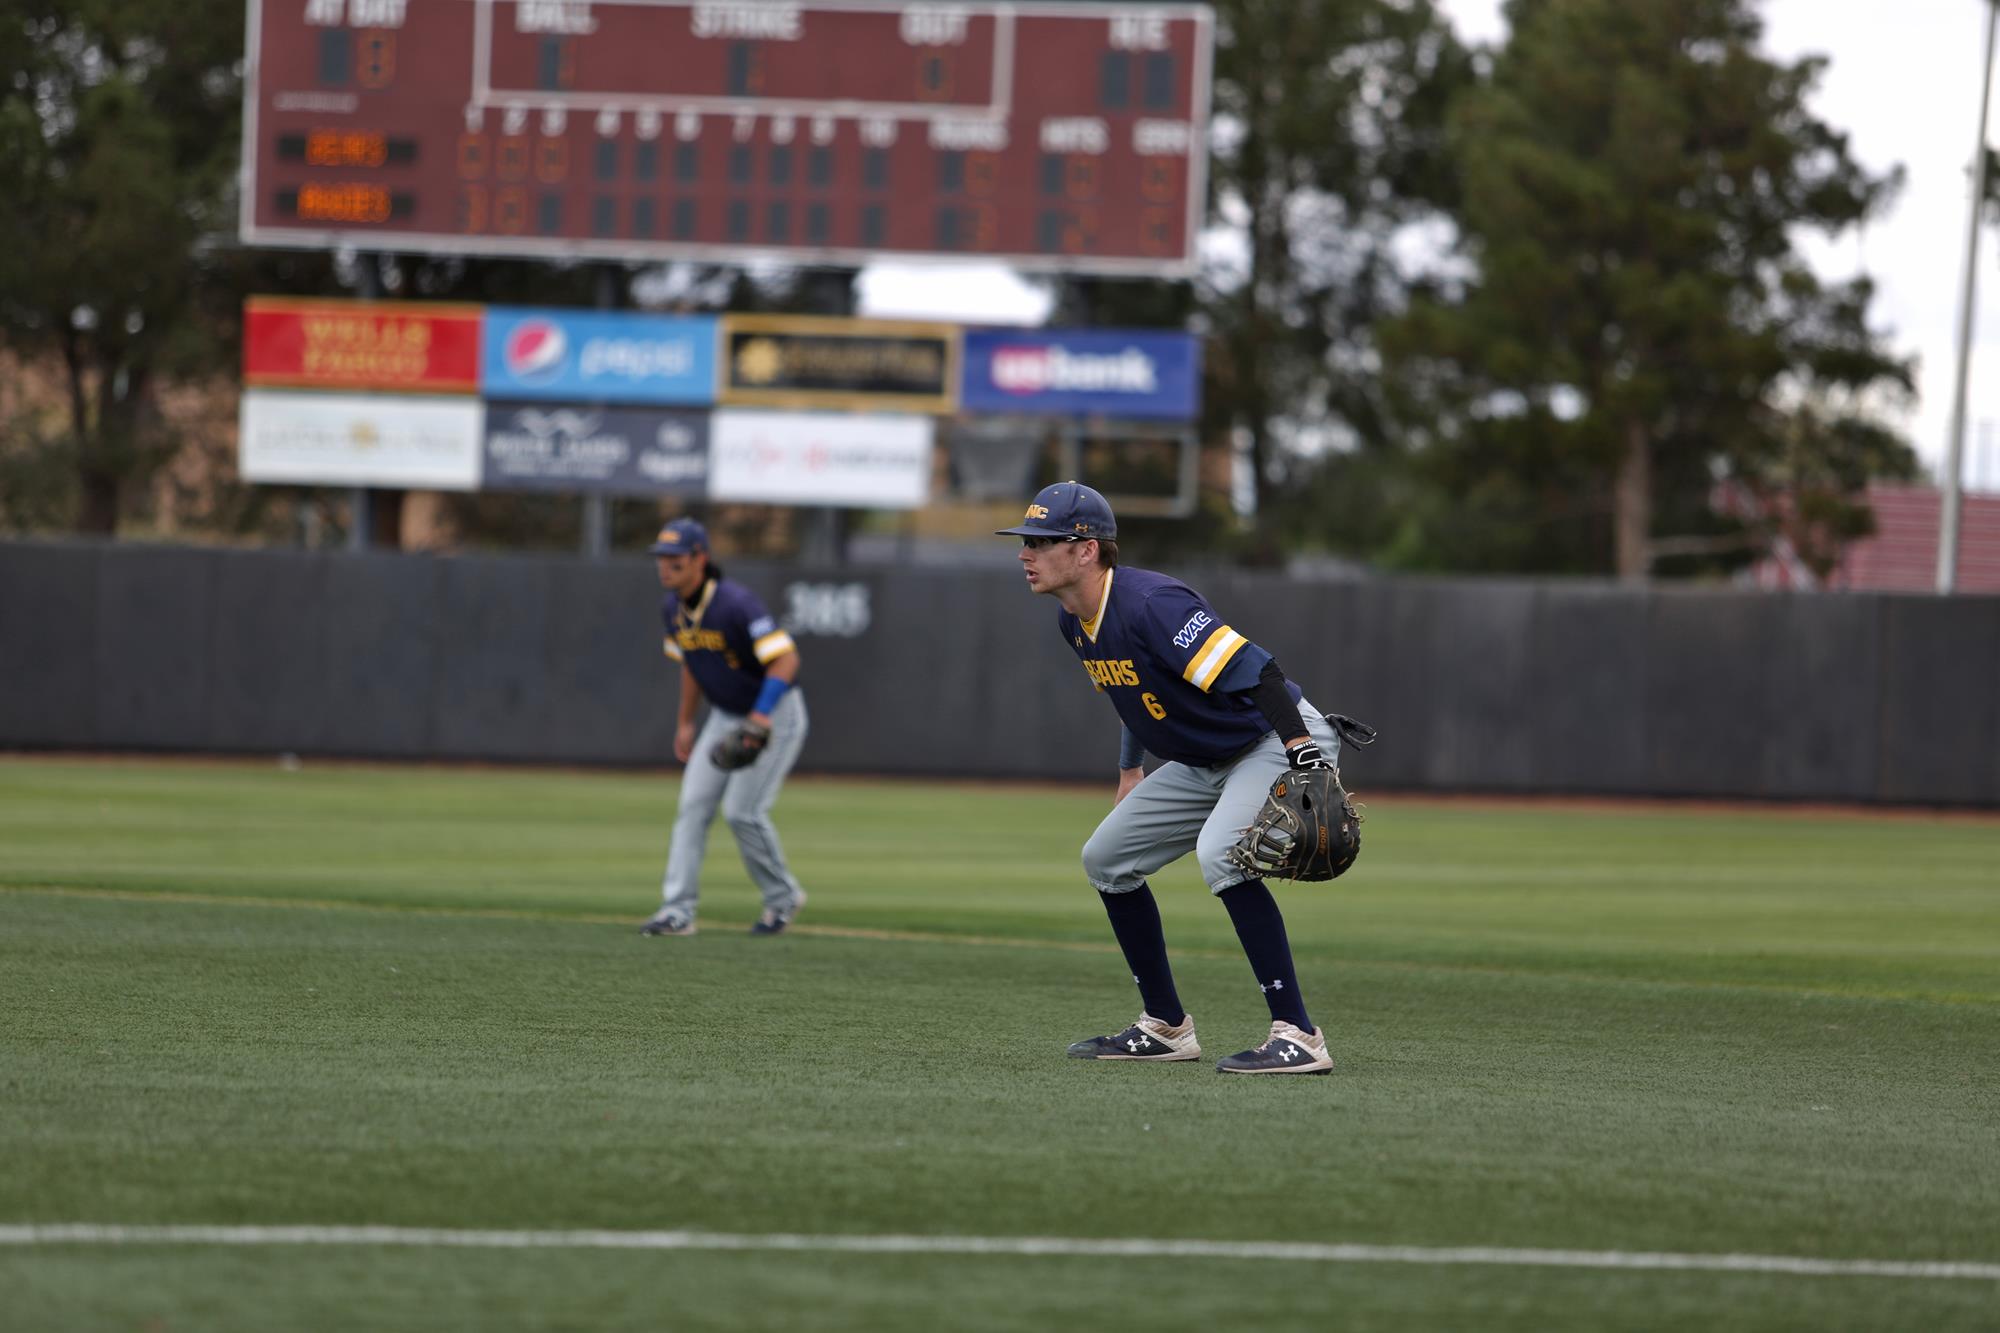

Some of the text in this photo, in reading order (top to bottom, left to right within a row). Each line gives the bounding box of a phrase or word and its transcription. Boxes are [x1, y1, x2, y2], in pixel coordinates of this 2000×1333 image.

[516, 0, 598, 33] BALL
[691, 3, 803, 41] STRIKE
[901, 7, 969, 46] OUT
[466, 103, 484, 133] 1
[302, 317, 431, 349] WELLS
[580, 335, 695, 380] pepsi
[1173, 610, 1212, 649] WAC
[1142, 692, 1167, 720] 6
